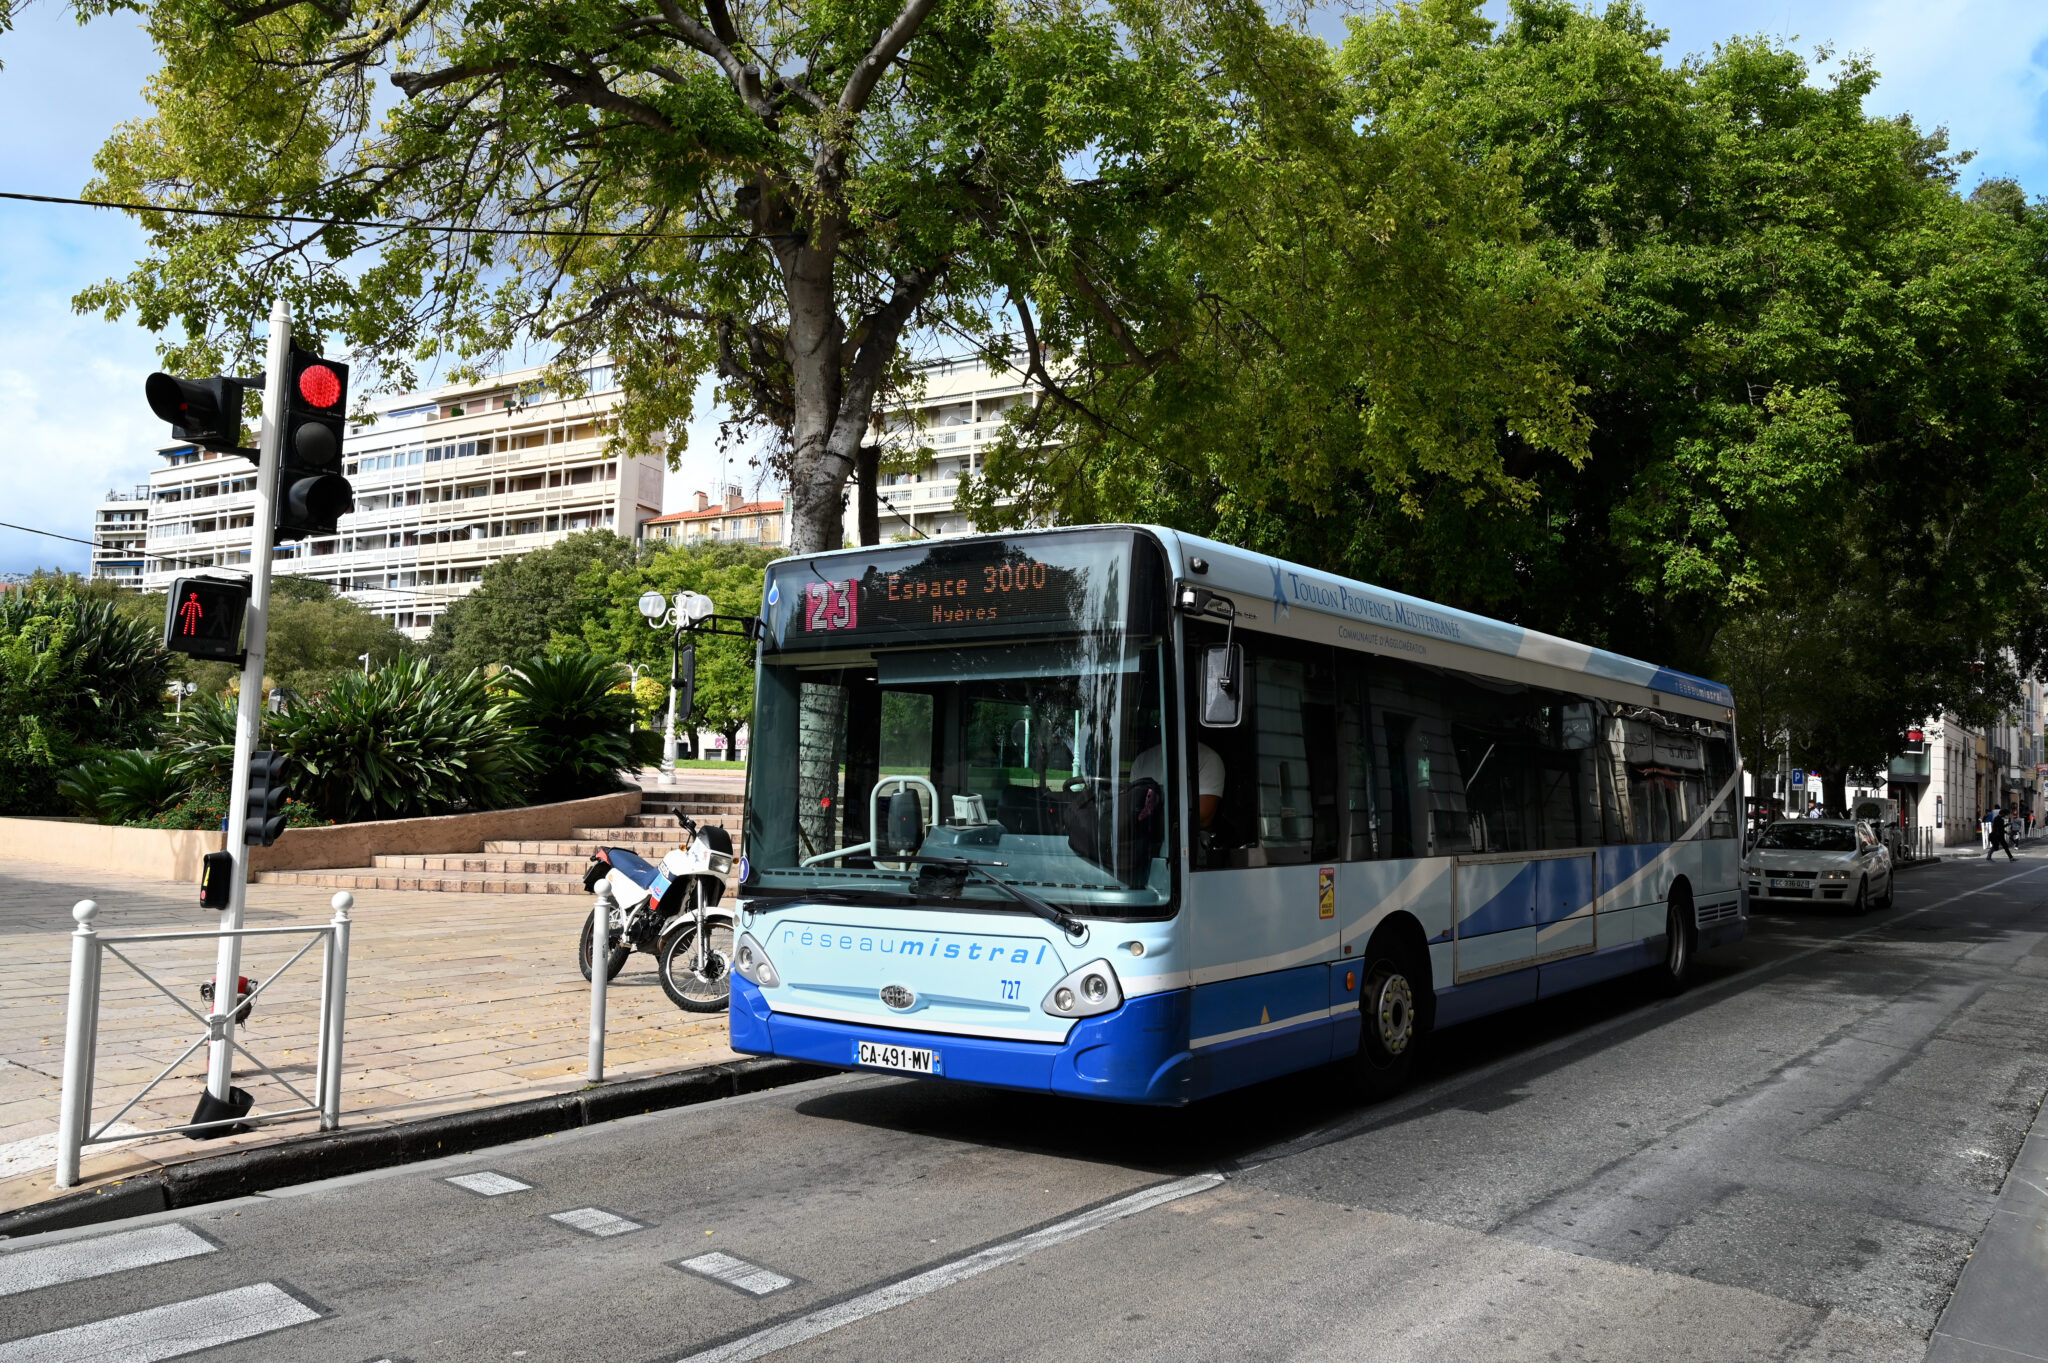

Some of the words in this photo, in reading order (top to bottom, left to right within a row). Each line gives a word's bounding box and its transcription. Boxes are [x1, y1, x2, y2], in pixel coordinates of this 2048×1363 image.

[888, 574, 968, 601] Espace
[983, 562, 1047, 593] 3000
[811, 582, 850, 630] 23
[932, 602, 998, 623] Hyères
[1289, 573, 1339, 609] TOULON
[1339, 585, 1393, 622] PROVENCE
[1394, 601, 1461, 639] MÉDITERRANÉE
[1001, 980, 1021, 1000] 727
[860, 1044, 930, 1070] CA-491-MV
